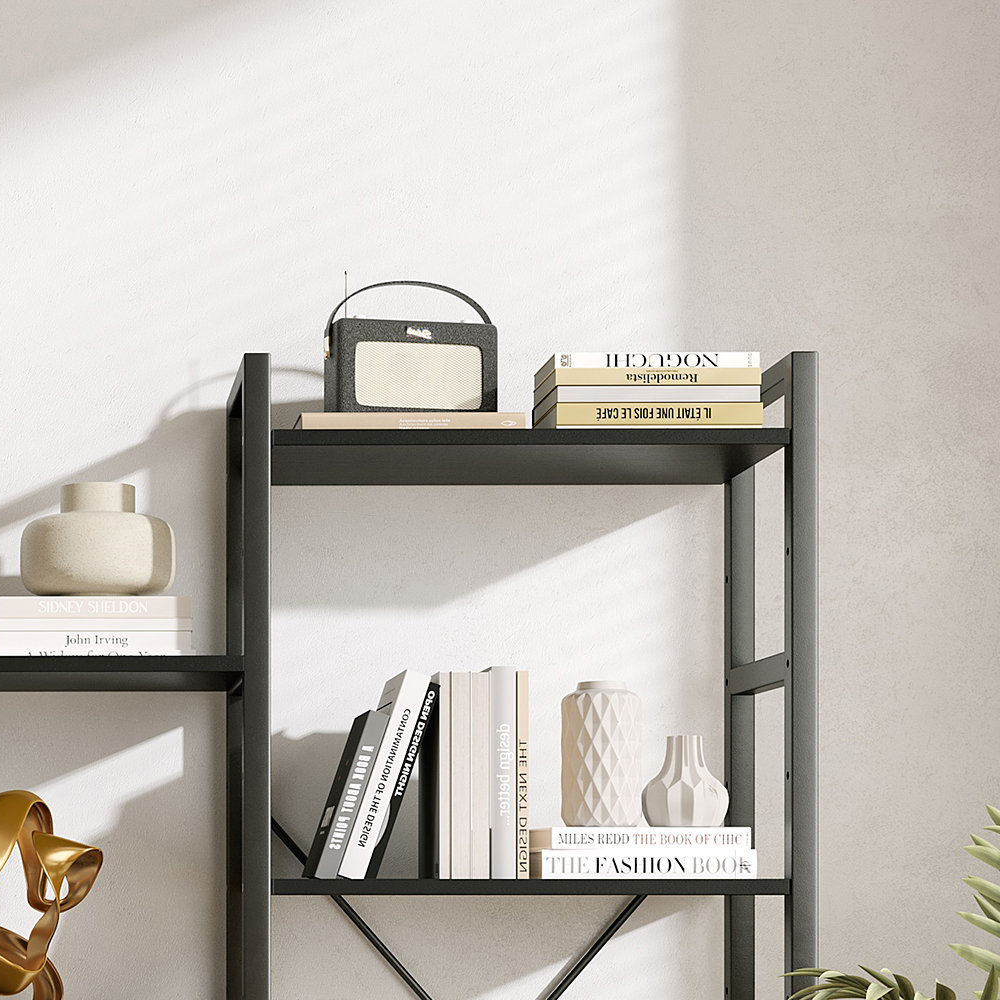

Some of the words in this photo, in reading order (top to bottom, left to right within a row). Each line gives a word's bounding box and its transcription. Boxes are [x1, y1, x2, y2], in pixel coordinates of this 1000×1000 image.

[606, 353, 718, 368] NOGUCHI
[626, 373, 698, 384] Remodelista
[596, 408, 619, 421] CAFÉ
[621, 408, 632, 418] LE
[634, 408, 654, 418] FOIS
[657, 408, 674, 418] UNE
[677, 408, 701, 421] ÉTAIT
[706, 408, 712, 418] IL
[38, 600, 83, 614] SIDNEY
[88, 600, 149, 614] SHELDON
[65, 635, 91, 648] John
[95, 635, 129, 648] Irving
[558, 833, 595, 845] MILES
[598, 833, 630, 845] REDD
[633, 833, 656, 845] THE
[660, 833, 692, 845] BOOK
[695, 833, 710, 845] OF
[713, 833, 743, 845] CHIC
[546, 856, 590, 874] THE
[595, 856, 686, 874] FASHION
[692, 856, 752, 874] BOOK
